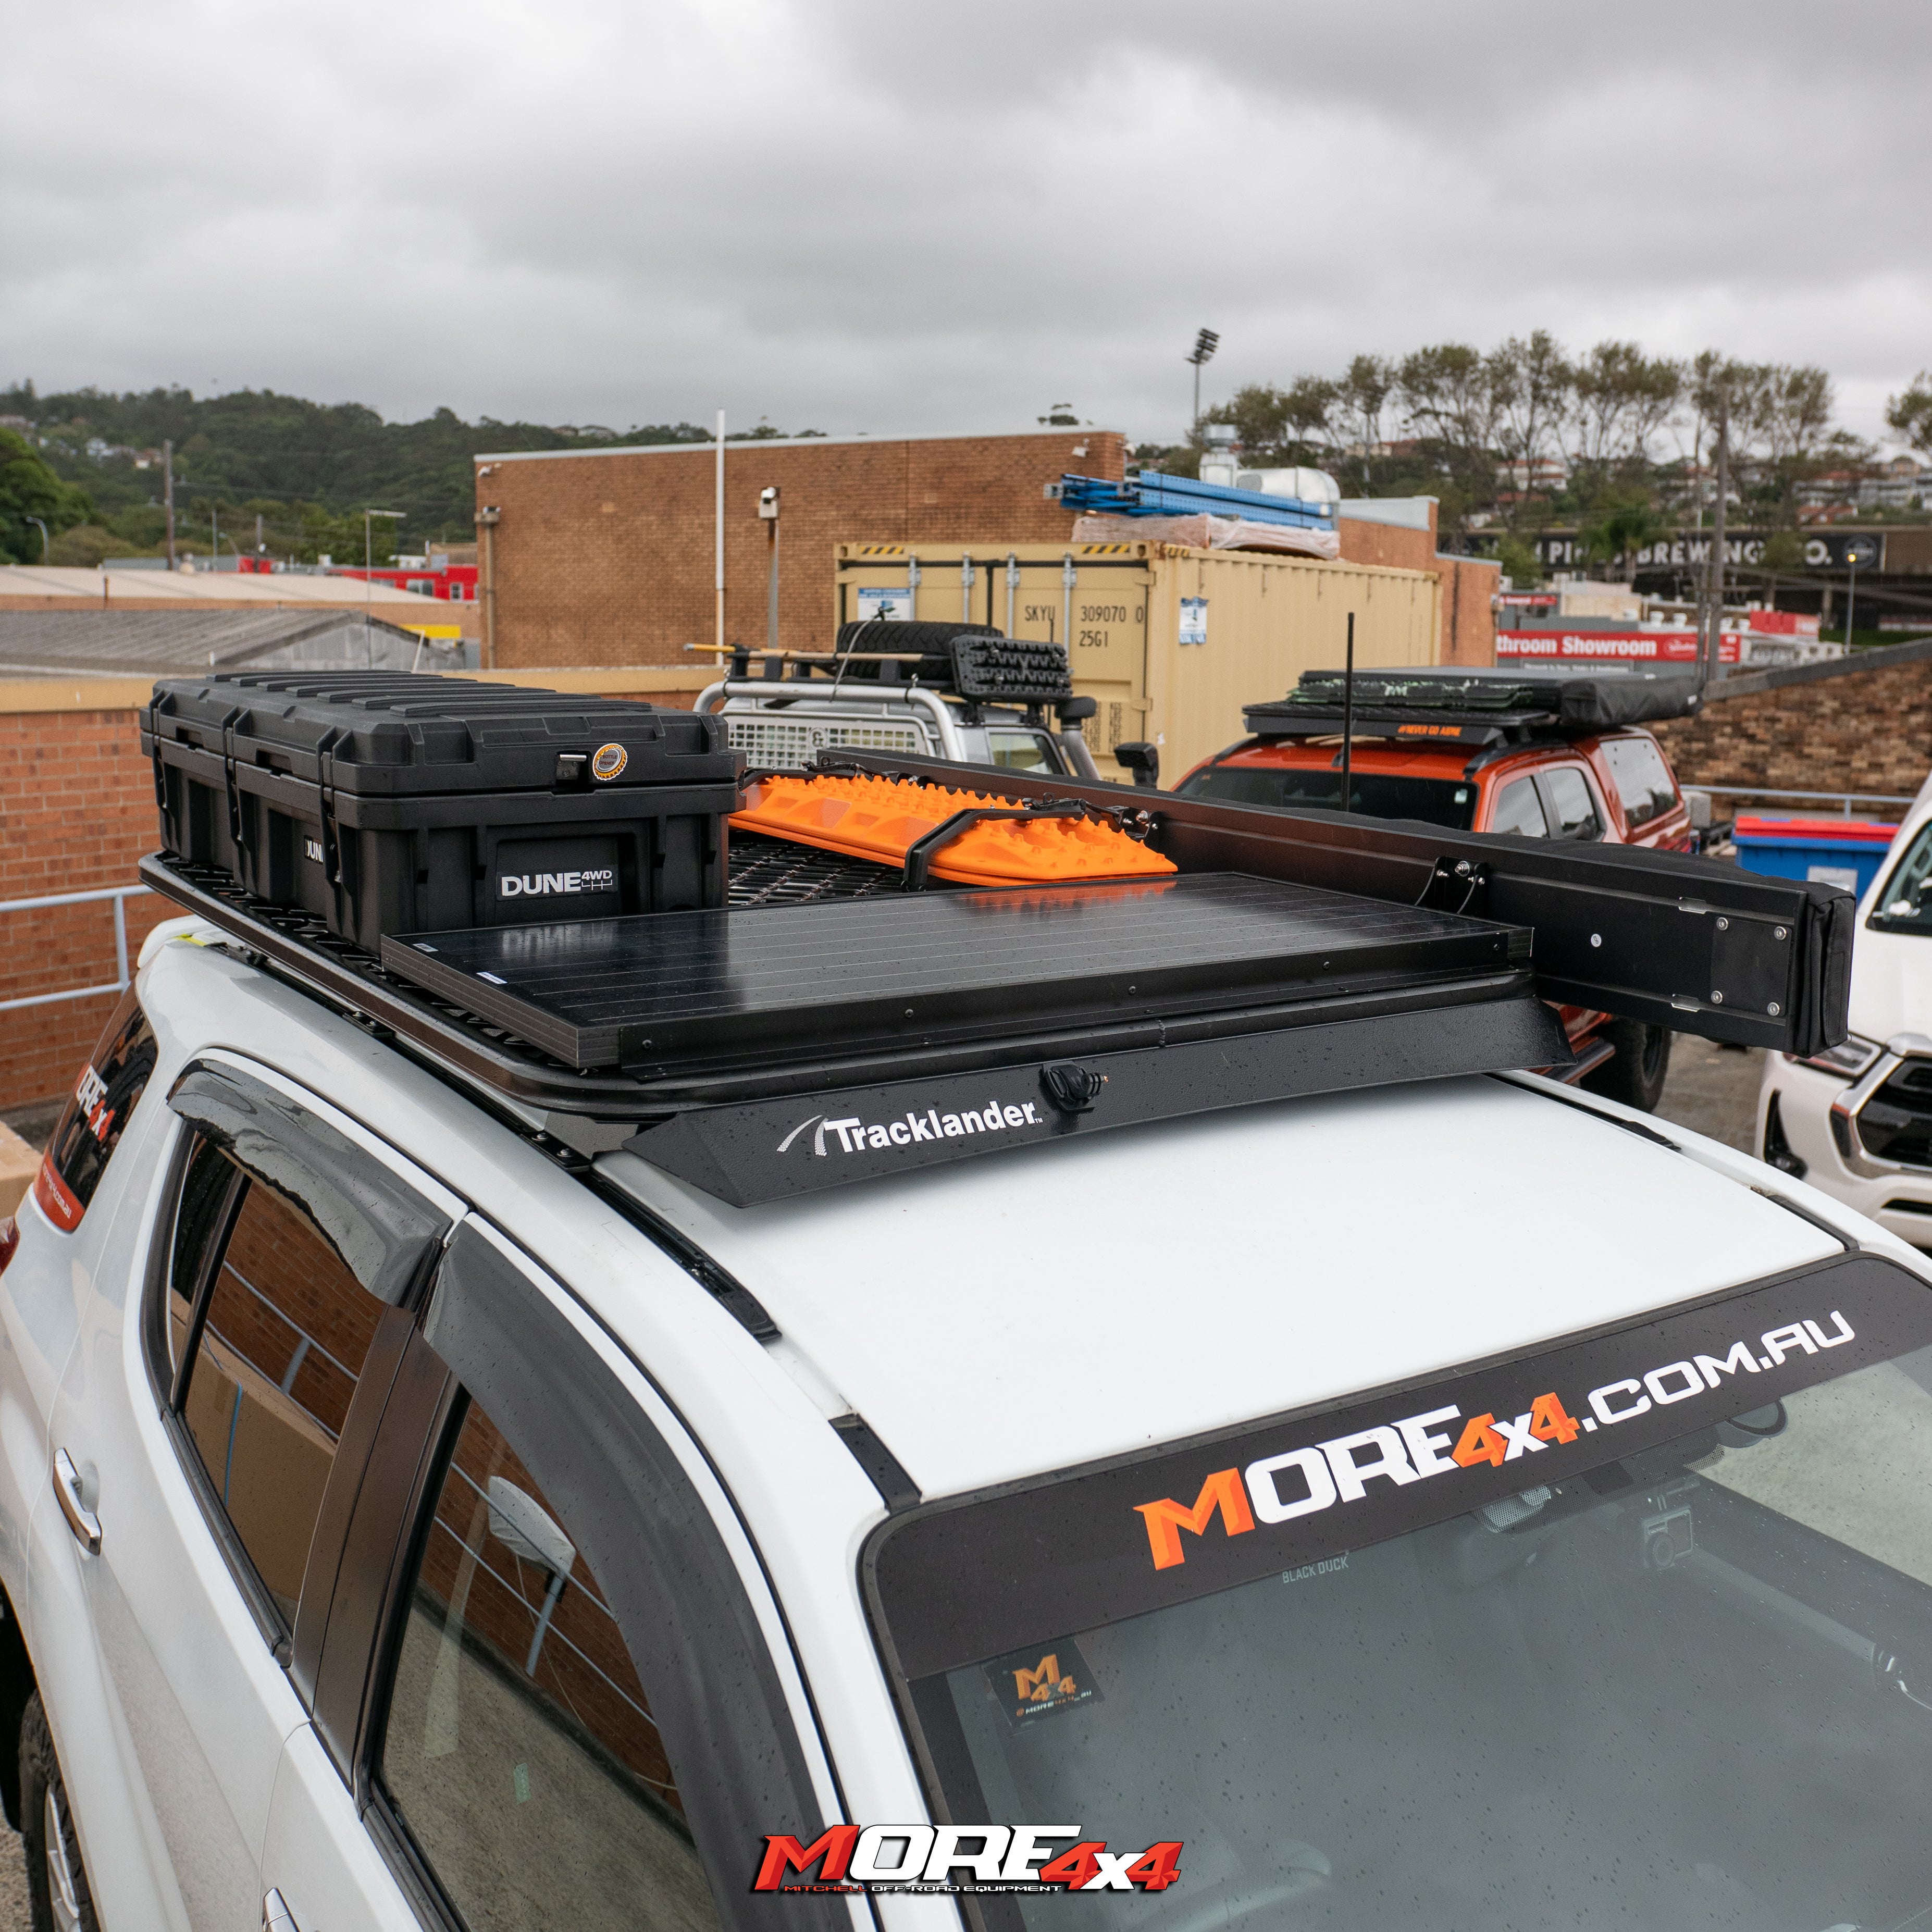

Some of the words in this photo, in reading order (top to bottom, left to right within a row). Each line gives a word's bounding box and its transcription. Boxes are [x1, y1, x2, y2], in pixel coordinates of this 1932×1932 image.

[1637, 540, 1765, 565] BREWNG
[1025, 605, 1055, 621] SKYU
[1081, 605, 1126, 622] 309070
[1135, 605, 1144, 623] 0
[1079, 630, 1108, 647] 25G1
[1562, 636, 1657, 657] Showroom
[502, 872, 581, 896] DUNE
[581, 870, 612, 881] 4WD
[76, 1064, 116, 1142] ORE4x4
[823, 1100, 1038, 1153] Tracklander
[1282, 1564, 1316, 1584] BLACK
[1318, 1556, 1349, 1575] DUCK
